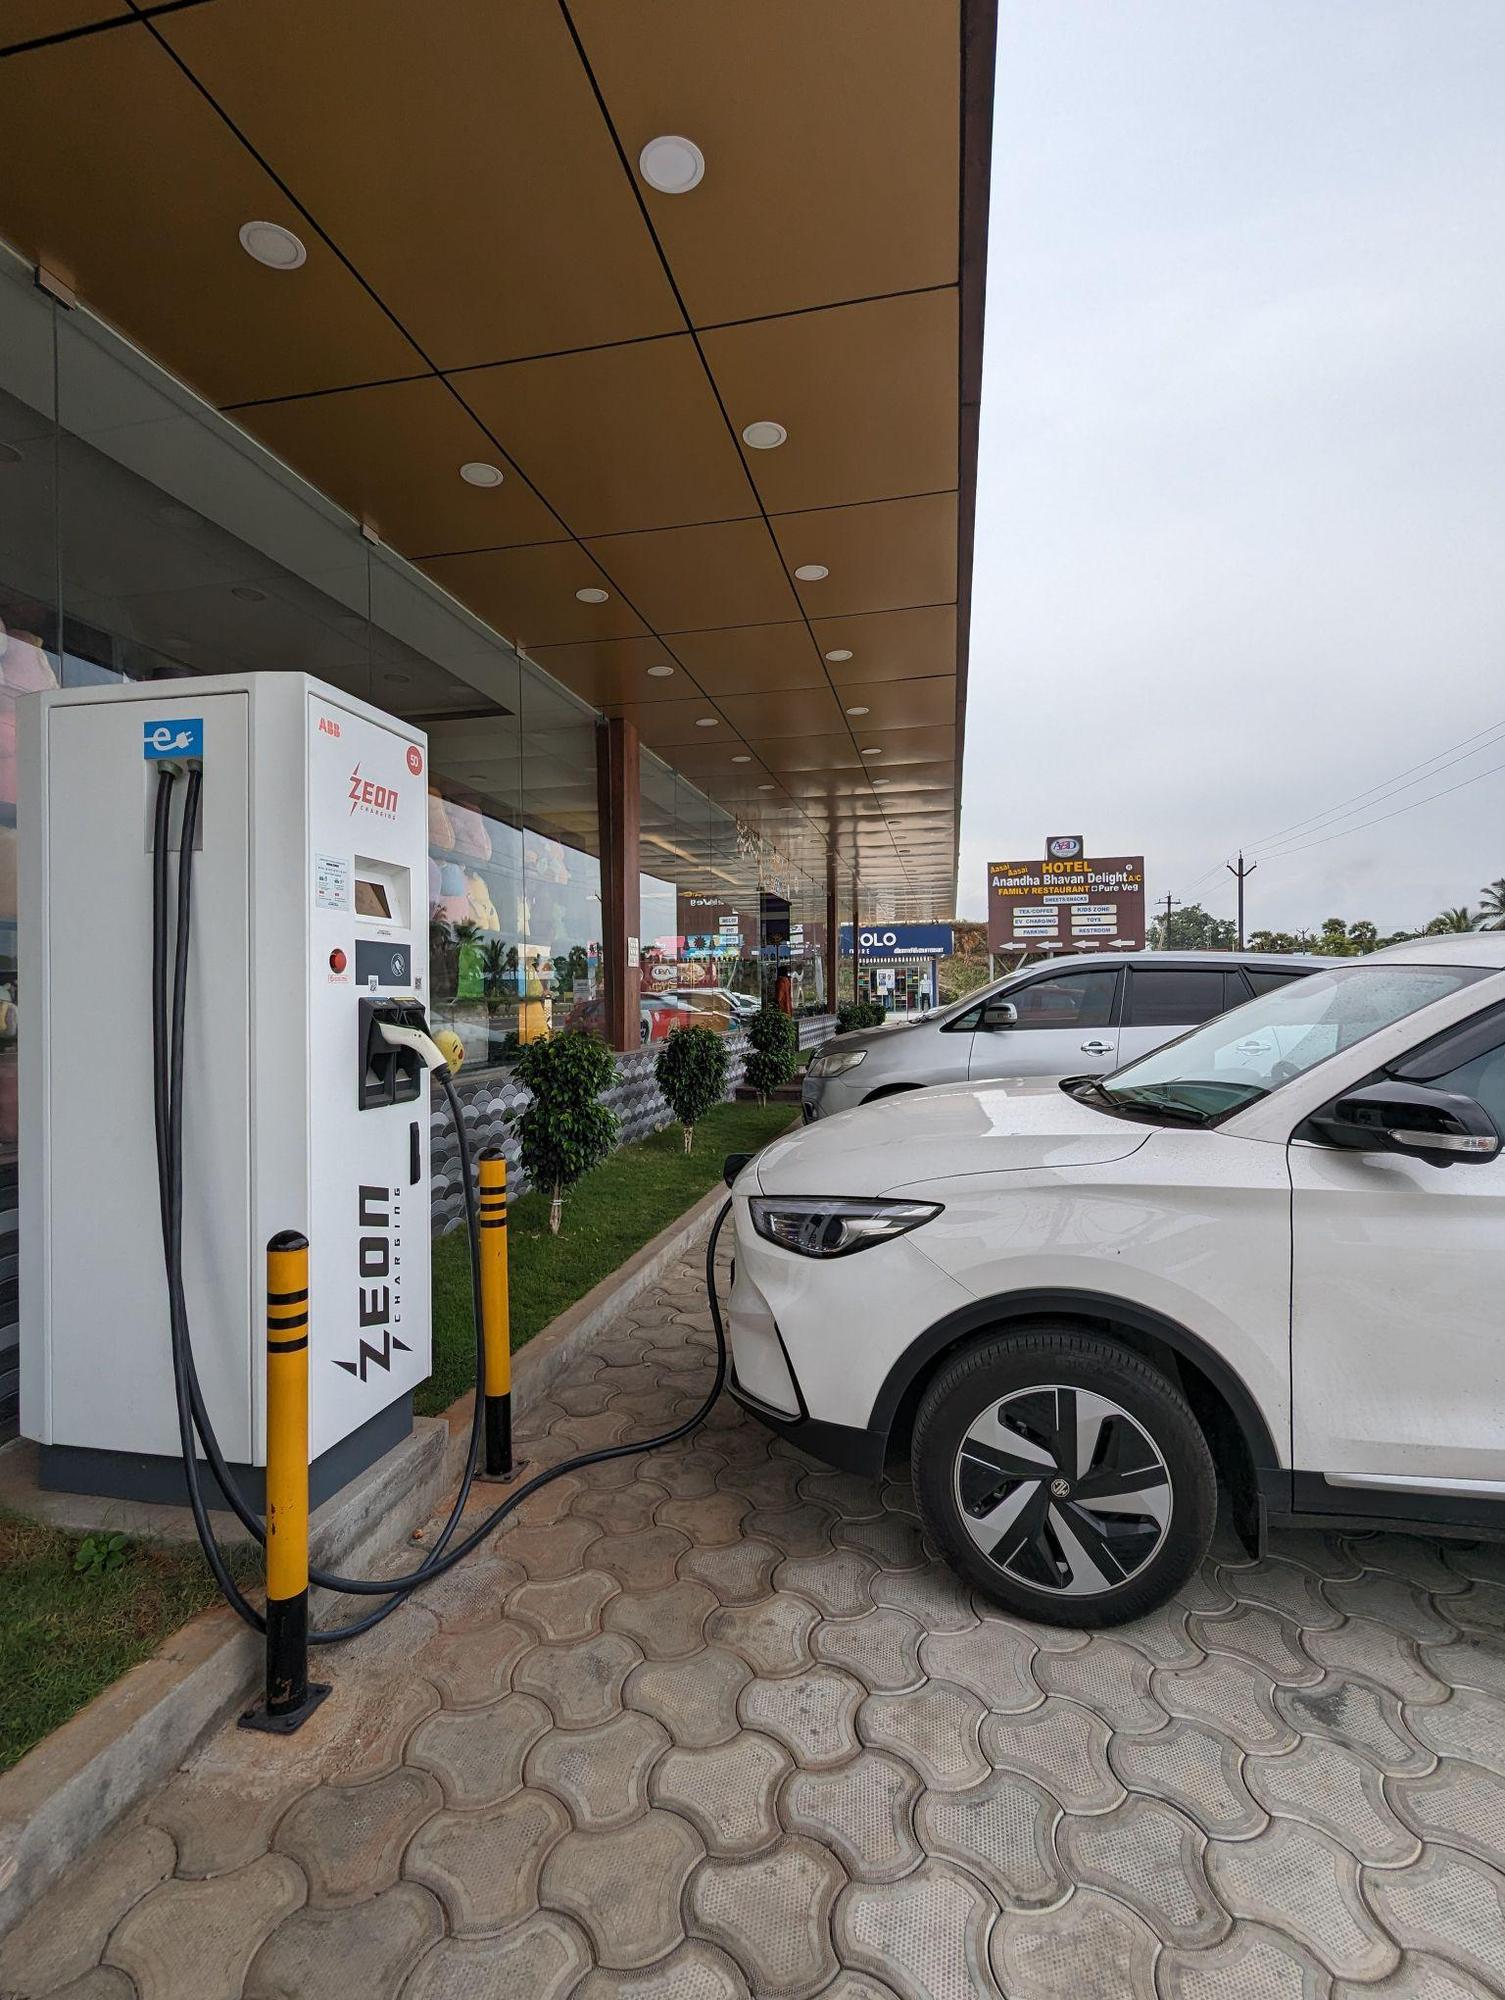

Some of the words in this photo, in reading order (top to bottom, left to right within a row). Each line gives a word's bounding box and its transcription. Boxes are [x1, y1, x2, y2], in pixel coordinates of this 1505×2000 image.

[319, 717, 341, 738] ABB
[348, 775, 399, 813] ZEON
[360, 804, 396, 821] CHARGING
[1042, 861, 1092, 873] HOTEL
[992, 875, 1040, 887] Anandha
[1043, 873, 1084, 885] Bhavan
[1088, 871, 1127, 885] Delight
[998, 887, 1029, 896] FAMILY
[1031, 885, 1090, 895] RESTAURANT
[1098, 884, 1119, 892] Pure
[1122, 882, 1139, 892] Veg
[858, 932, 897, 947] OLO
[359, 1185, 390, 1383] ZEON
